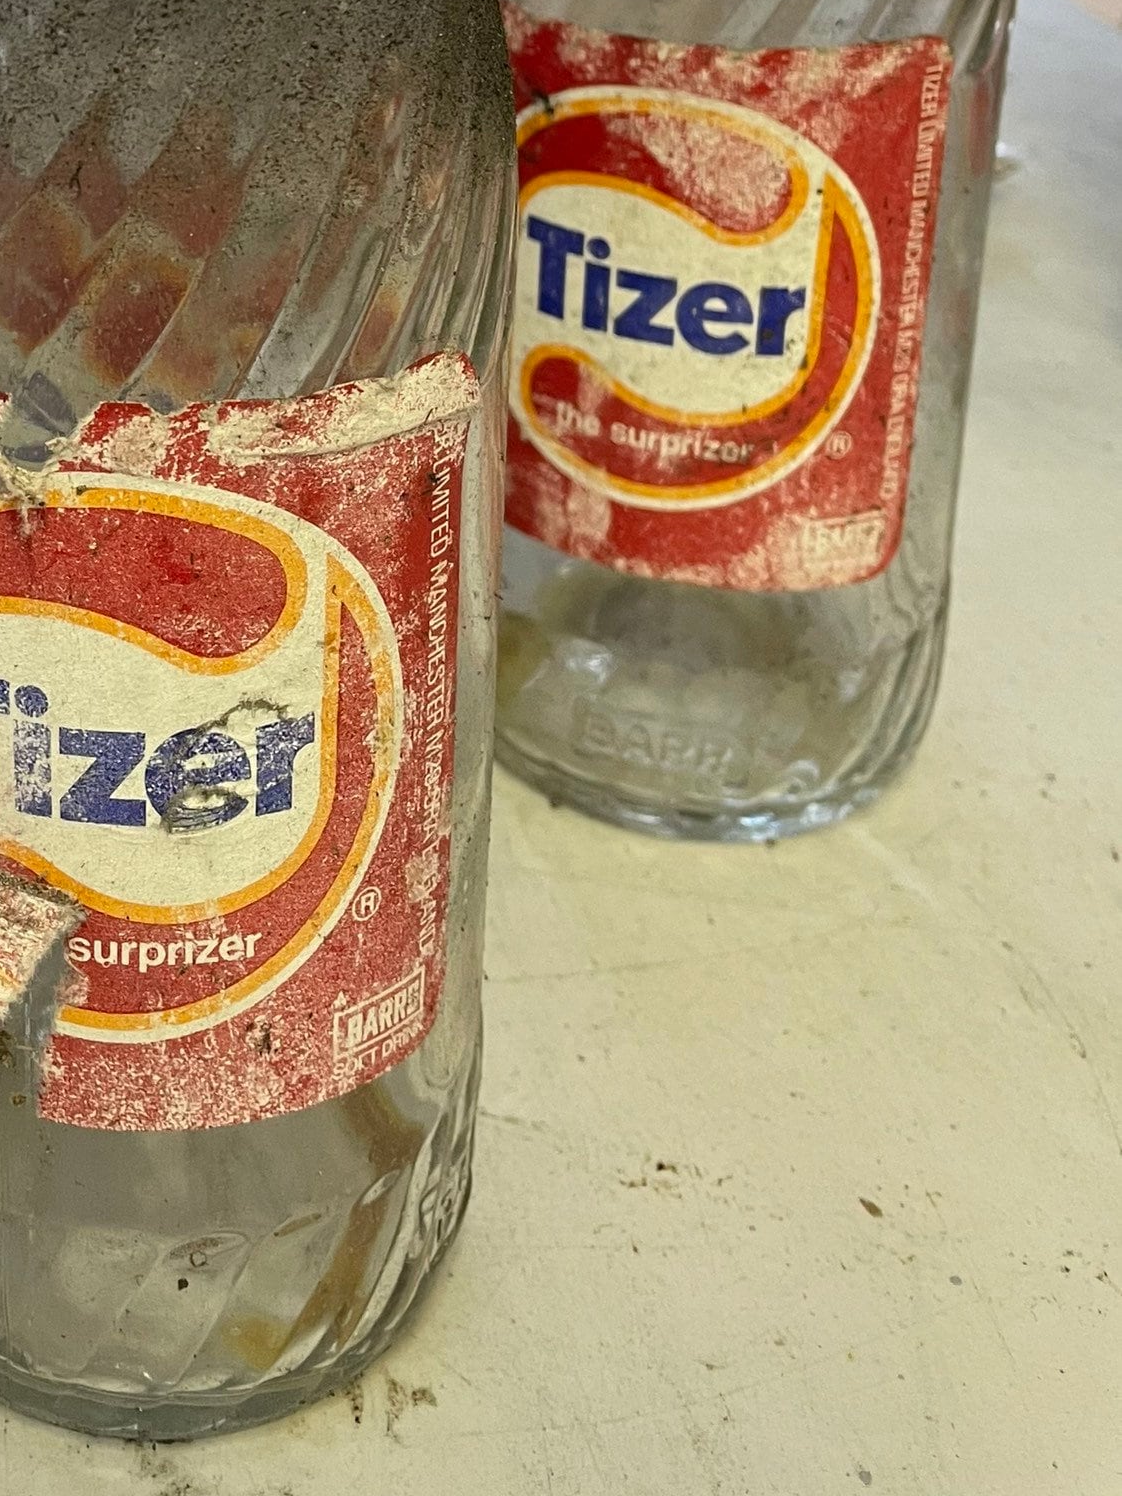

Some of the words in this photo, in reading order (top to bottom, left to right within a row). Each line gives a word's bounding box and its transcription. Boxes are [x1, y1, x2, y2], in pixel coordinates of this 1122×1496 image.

[526, 215, 806, 356] Tizer
[610, 421, 754, 470] surprizer
[431, 457, 451, 557] LIMITED
[427, 560, 448, 730] MANCHESTER
[68, 932, 262, 973] surprizer
[347, 979, 419, 1048] BARRS
